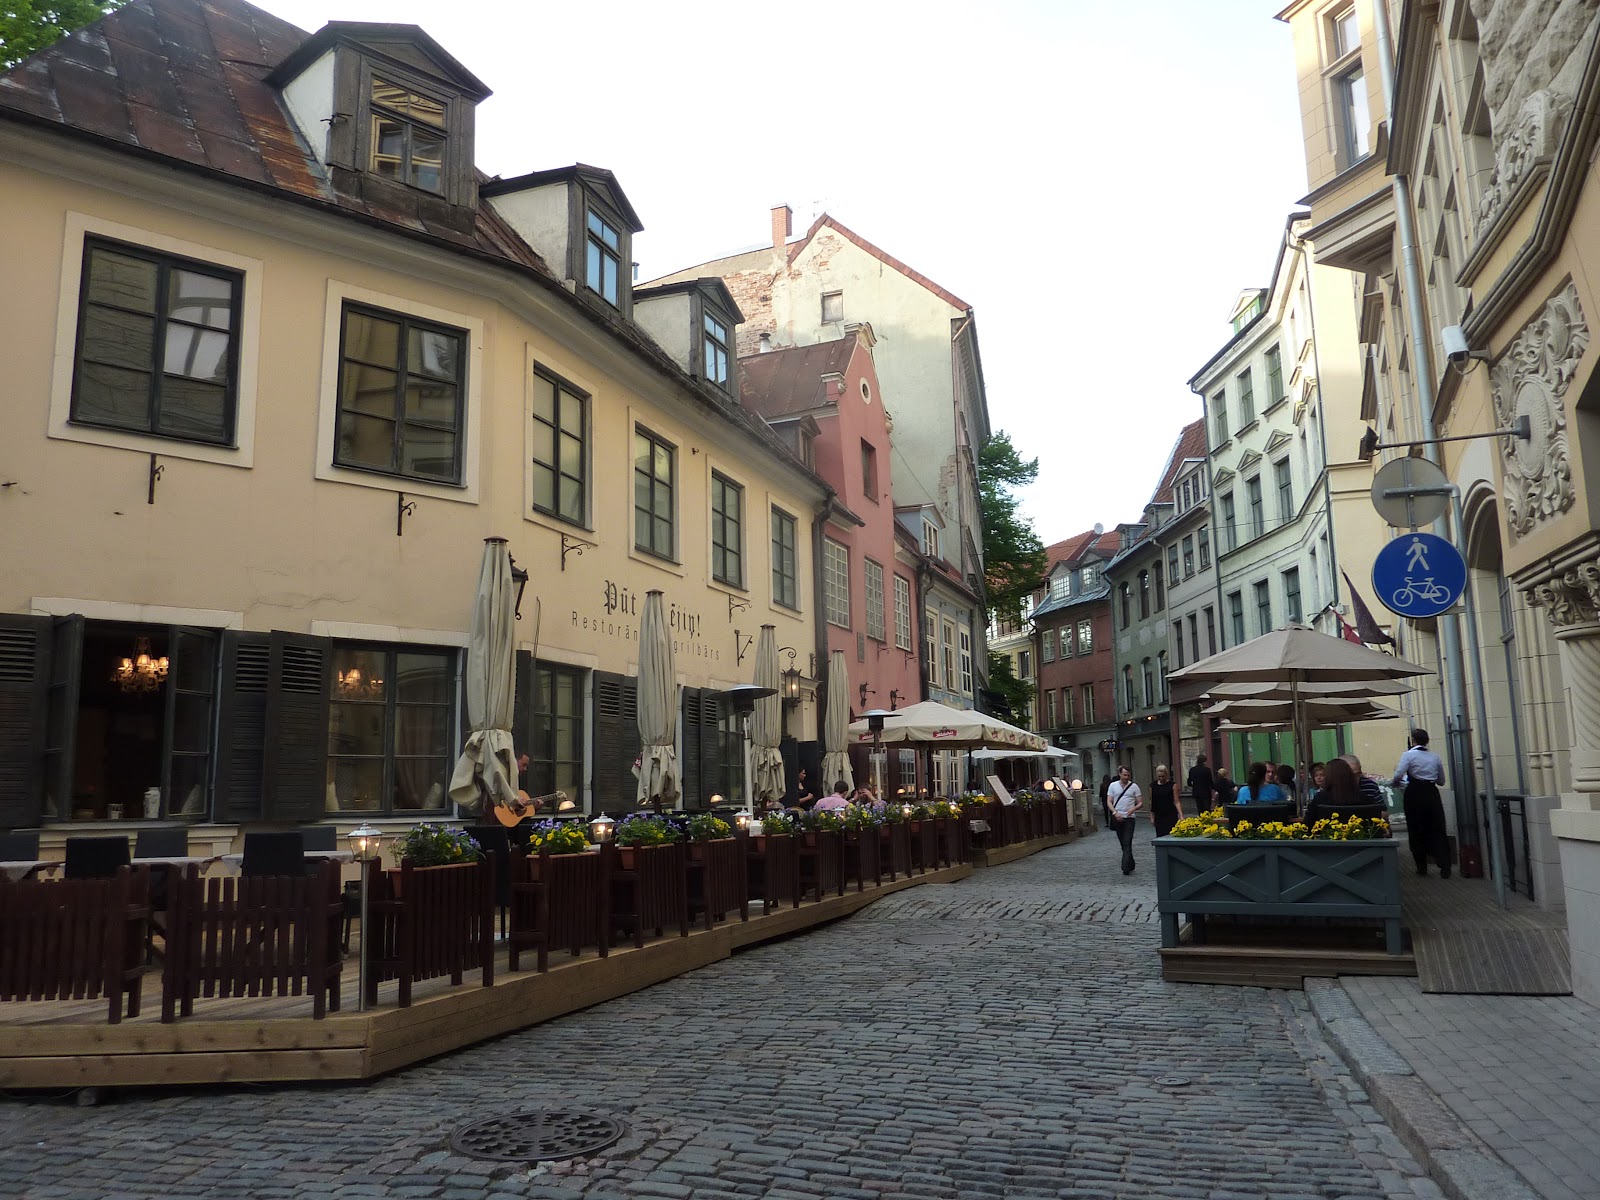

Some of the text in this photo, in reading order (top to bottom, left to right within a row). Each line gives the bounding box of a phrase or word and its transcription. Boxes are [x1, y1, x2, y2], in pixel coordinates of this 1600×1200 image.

[572, 610, 720, 661] Restorān grilbārs
[604, 580, 700, 639] Pūt ējiņ!
